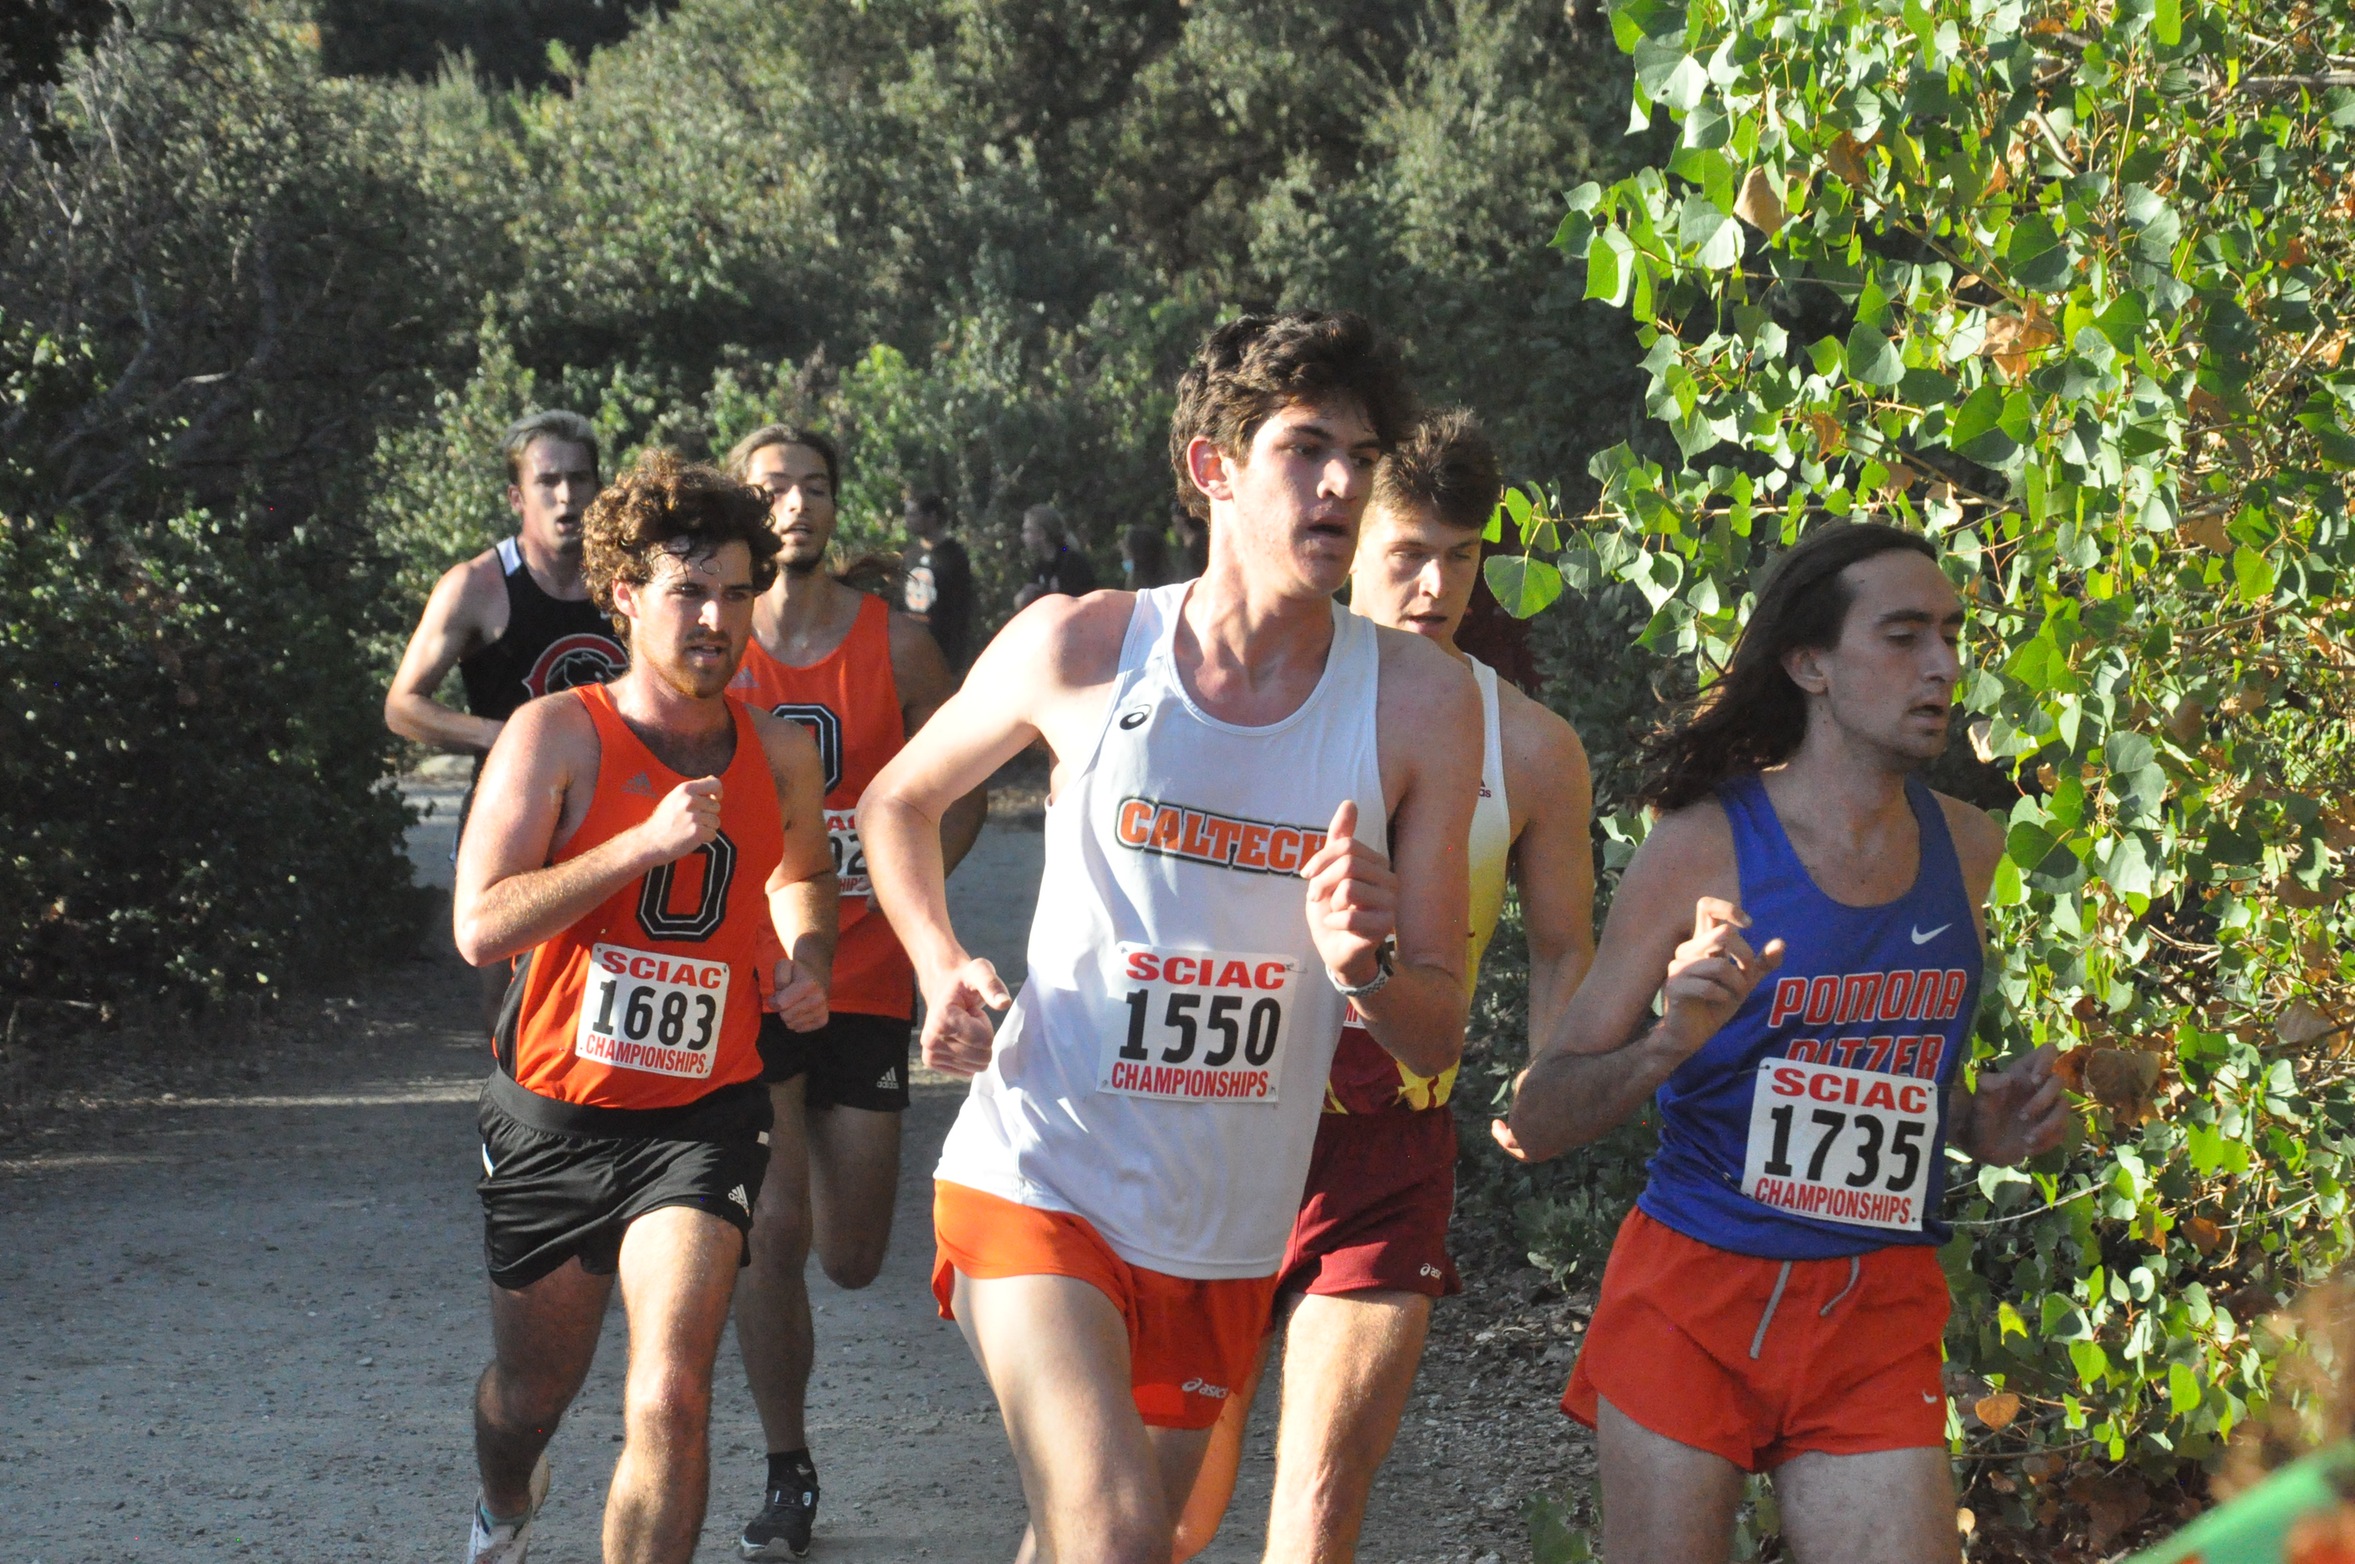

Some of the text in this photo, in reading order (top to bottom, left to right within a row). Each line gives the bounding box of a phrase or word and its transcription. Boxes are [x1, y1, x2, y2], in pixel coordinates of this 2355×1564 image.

[602, 951, 722, 989] SCIAC
[1126, 952, 1286, 990] SCIAC
[592, 979, 716, 1051] 1683
[1768, 969, 1967, 1028] POMONA
[1119, 988, 1281, 1066] 1550
[586, 1034, 707, 1075] CHAMPIONSHIPS
[1111, 1061, 1269, 1098] CHAMPIONSHIPS
[1771, 1067, 1927, 1114] SCIAC
[1764, 1104, 1926, 1192] 1735
[1755, 1177, 1912, 1225] CHAMPIONSHIPS
